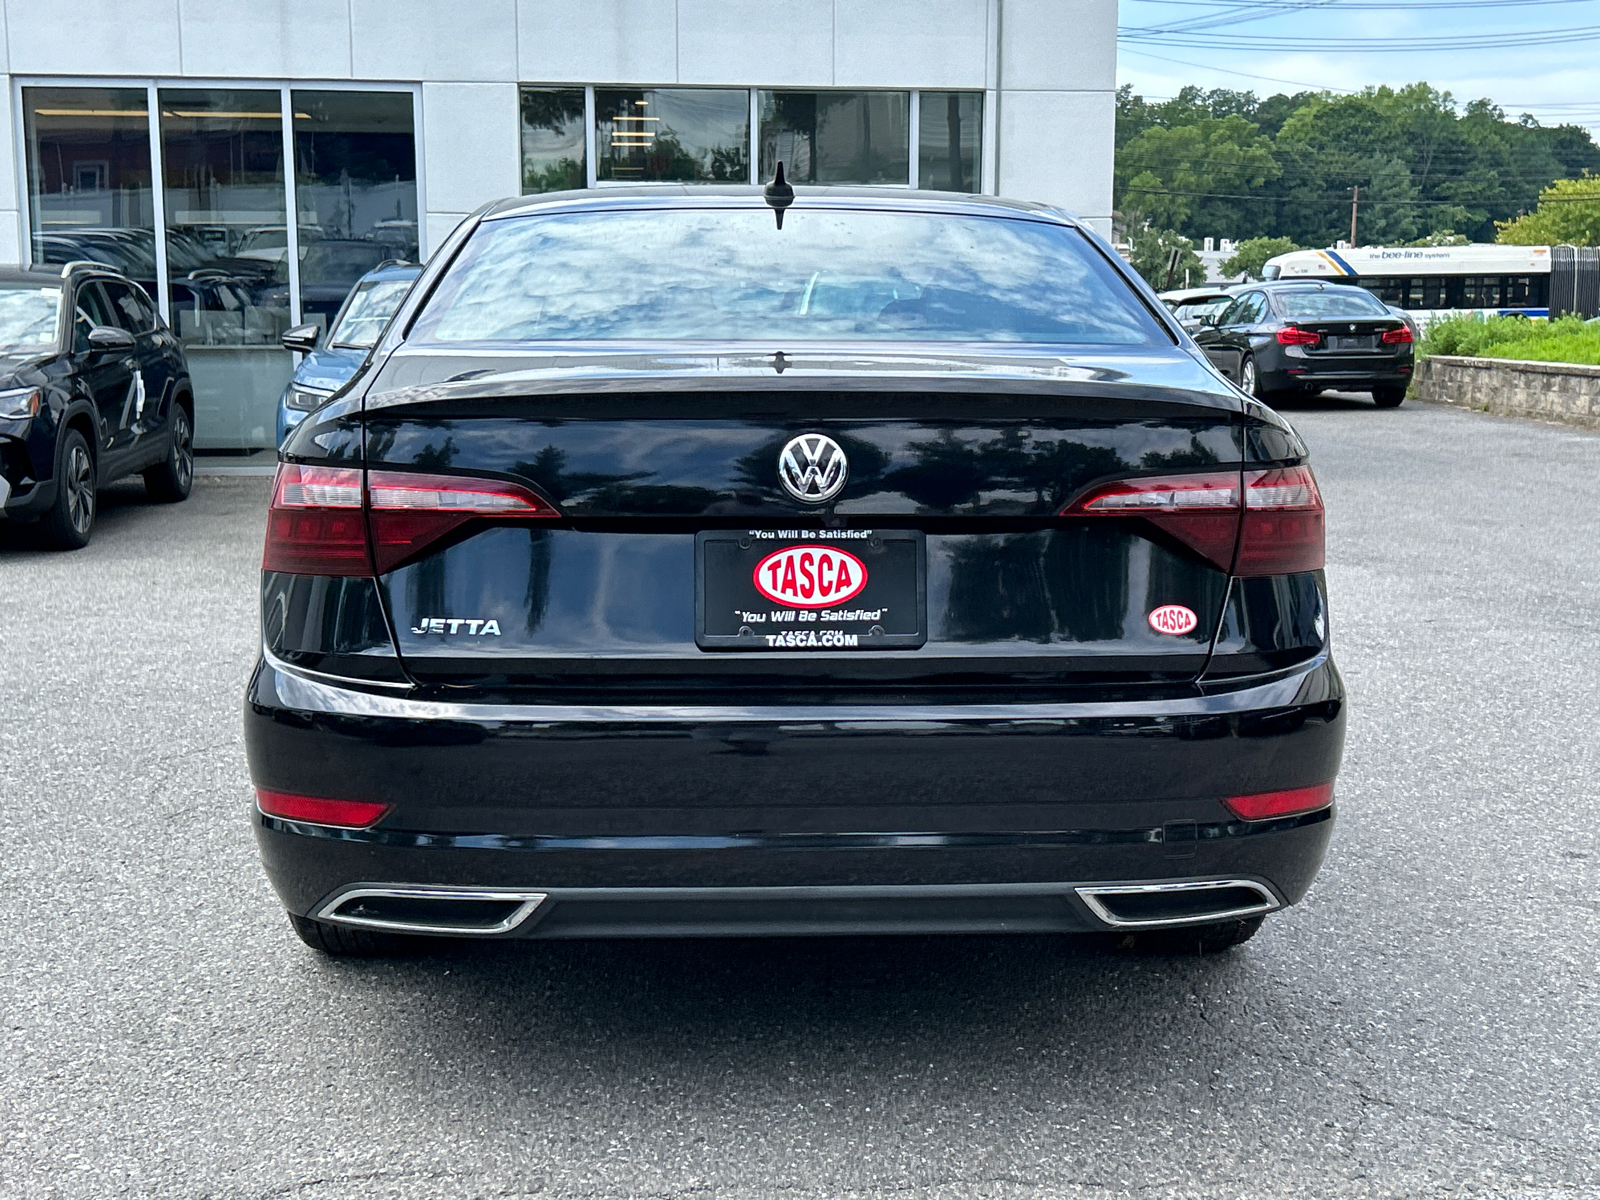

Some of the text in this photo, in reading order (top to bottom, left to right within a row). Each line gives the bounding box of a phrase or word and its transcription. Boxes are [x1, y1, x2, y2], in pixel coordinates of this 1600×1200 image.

[1381, 250, 1424, 259] bee-line
[779, 433, 847, 501] VW
[777, 529, 798, 539] Will
[801, 529, 816, 539] Be
[767, 551, 852, 599] TASCA
[770, 610, 796, 622] Will
[798, 610, 817, 622] Be
[1155, 609, 1191, 631] TASCA
[410, 617, 502, 636] JETTA
[765, 634, 858, 647] TASCA.COM
